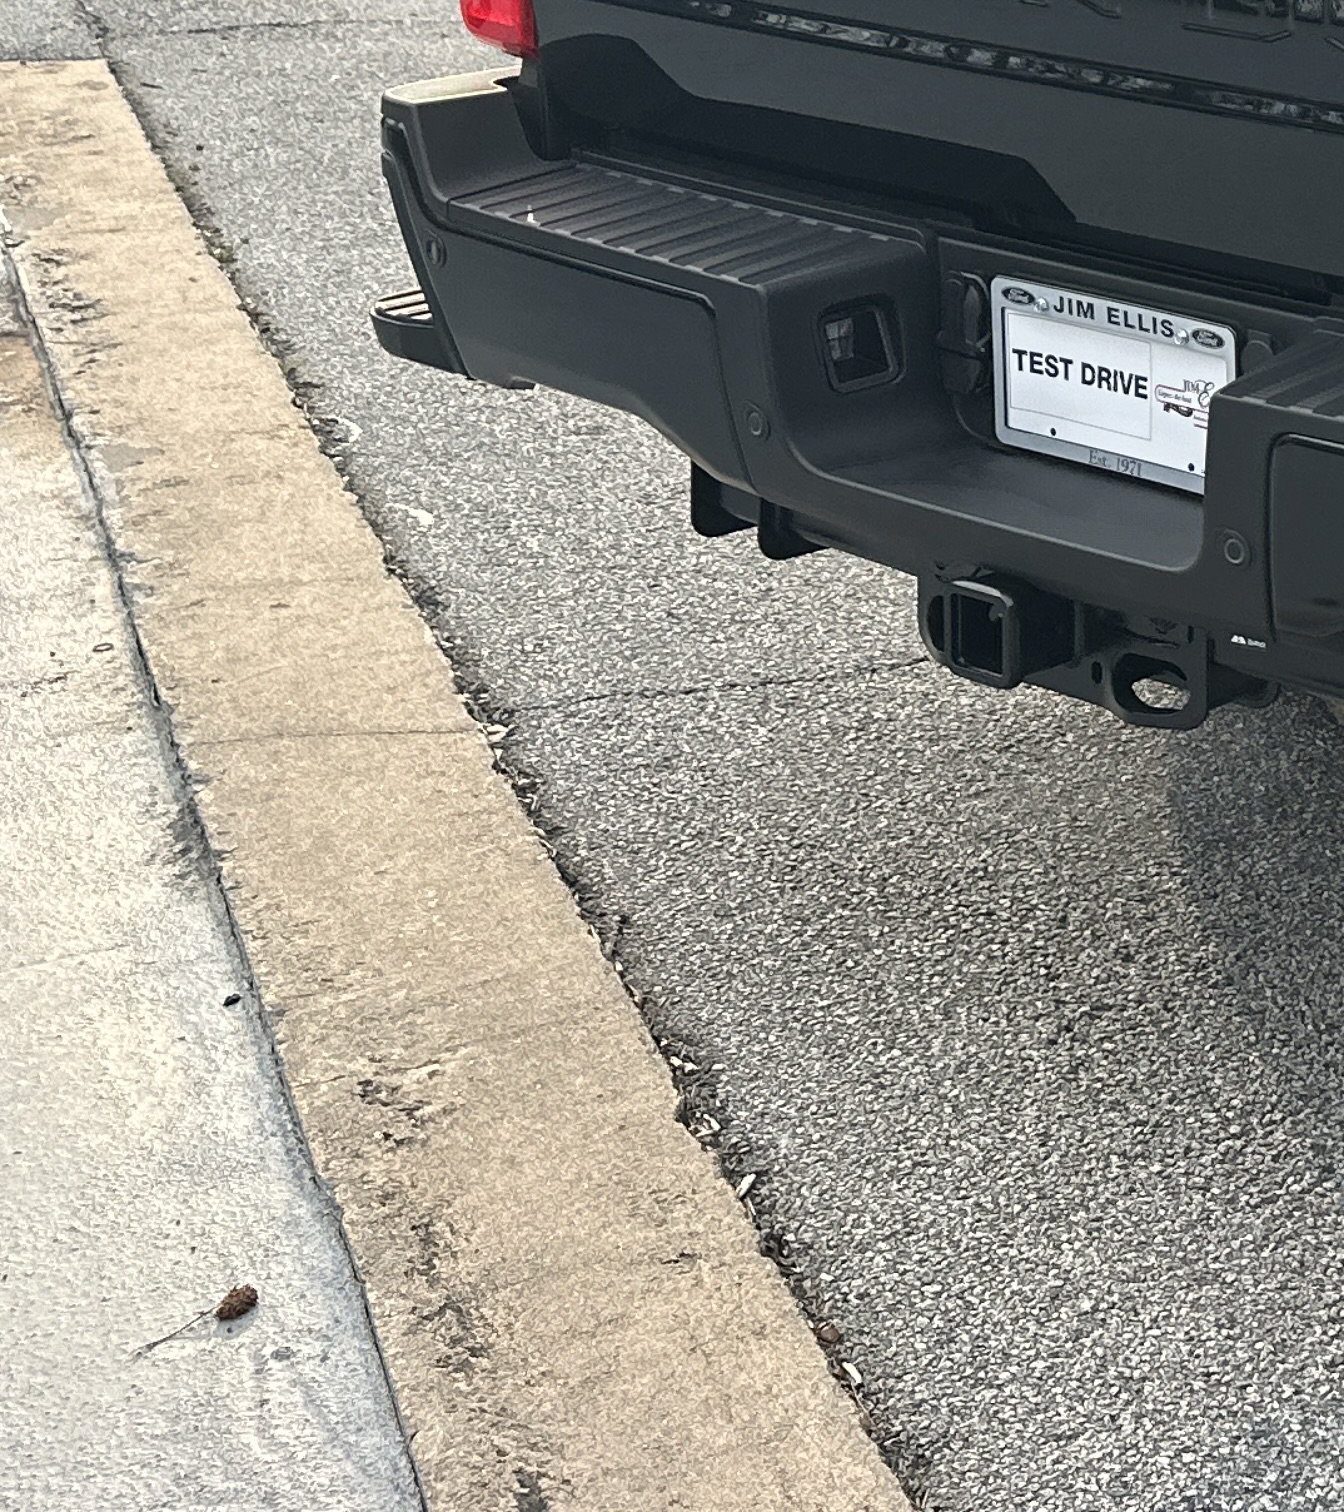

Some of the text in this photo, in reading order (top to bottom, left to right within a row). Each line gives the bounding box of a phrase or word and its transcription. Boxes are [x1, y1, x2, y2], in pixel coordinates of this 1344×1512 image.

[1053, 296, 1175, 338] JIM ELLIS
[1012, 348, 1149, 400] TEST DRIVE
[1116, 457, 1142, 477] 1971
